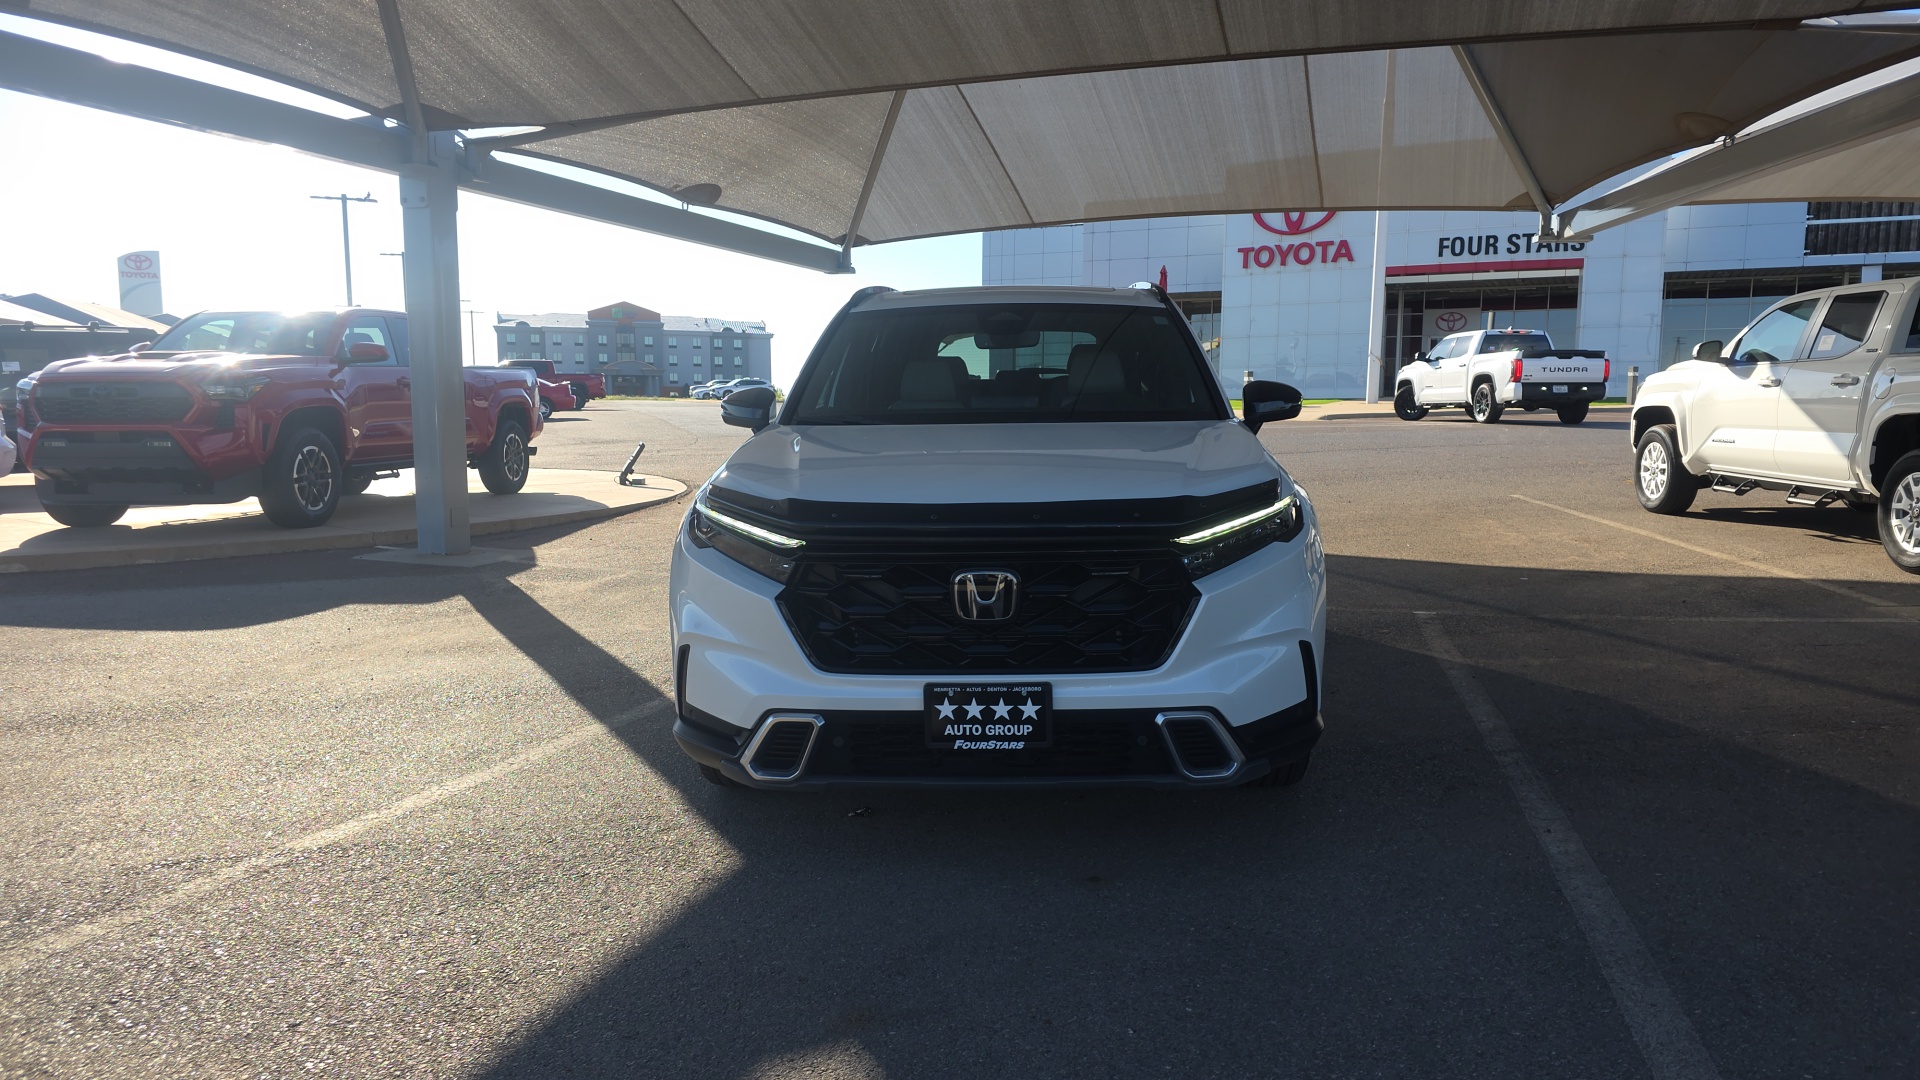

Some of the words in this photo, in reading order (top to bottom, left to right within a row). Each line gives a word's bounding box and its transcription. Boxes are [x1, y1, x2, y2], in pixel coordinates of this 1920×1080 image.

[1237, 239, 1354, 269] TOYOTA
[1438, 235, 1499, 257] FOUR
[120, 271, 159, 280] TOYOTA
[944, 724, 982, 736] AUTO
[985, 724, 1033, 736] GROUP
